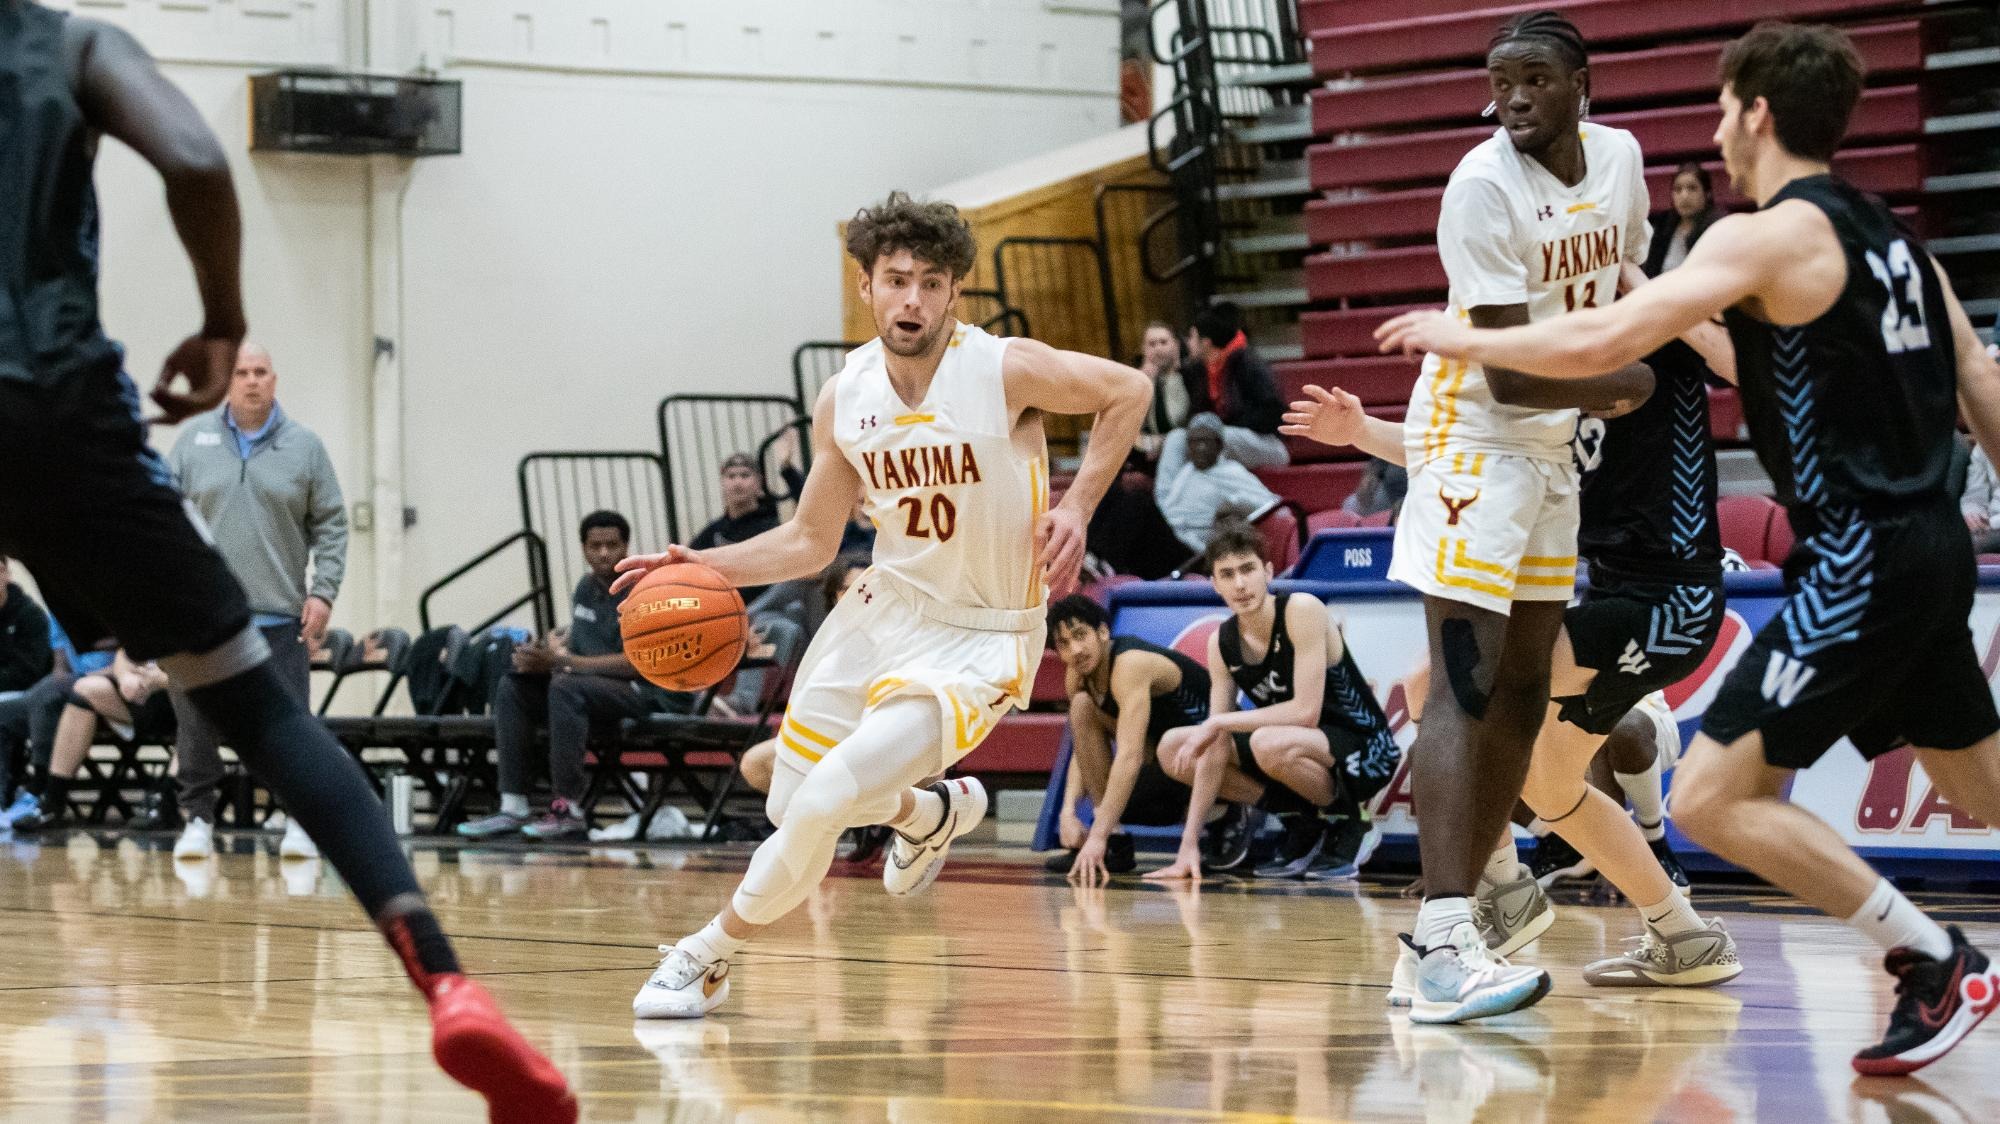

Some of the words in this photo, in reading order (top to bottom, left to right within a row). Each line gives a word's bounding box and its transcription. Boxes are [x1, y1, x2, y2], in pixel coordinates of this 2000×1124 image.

[1541, 224, 1619, 283] YAKIMA
[1864, 239, 1931, 354] 23
[861, 442, 982, 489] YAKIMA
[898, 493, 956, 543] 20
[1344, 547, 1373, 568] POSS
[1760, 650, 1818, 709] W
